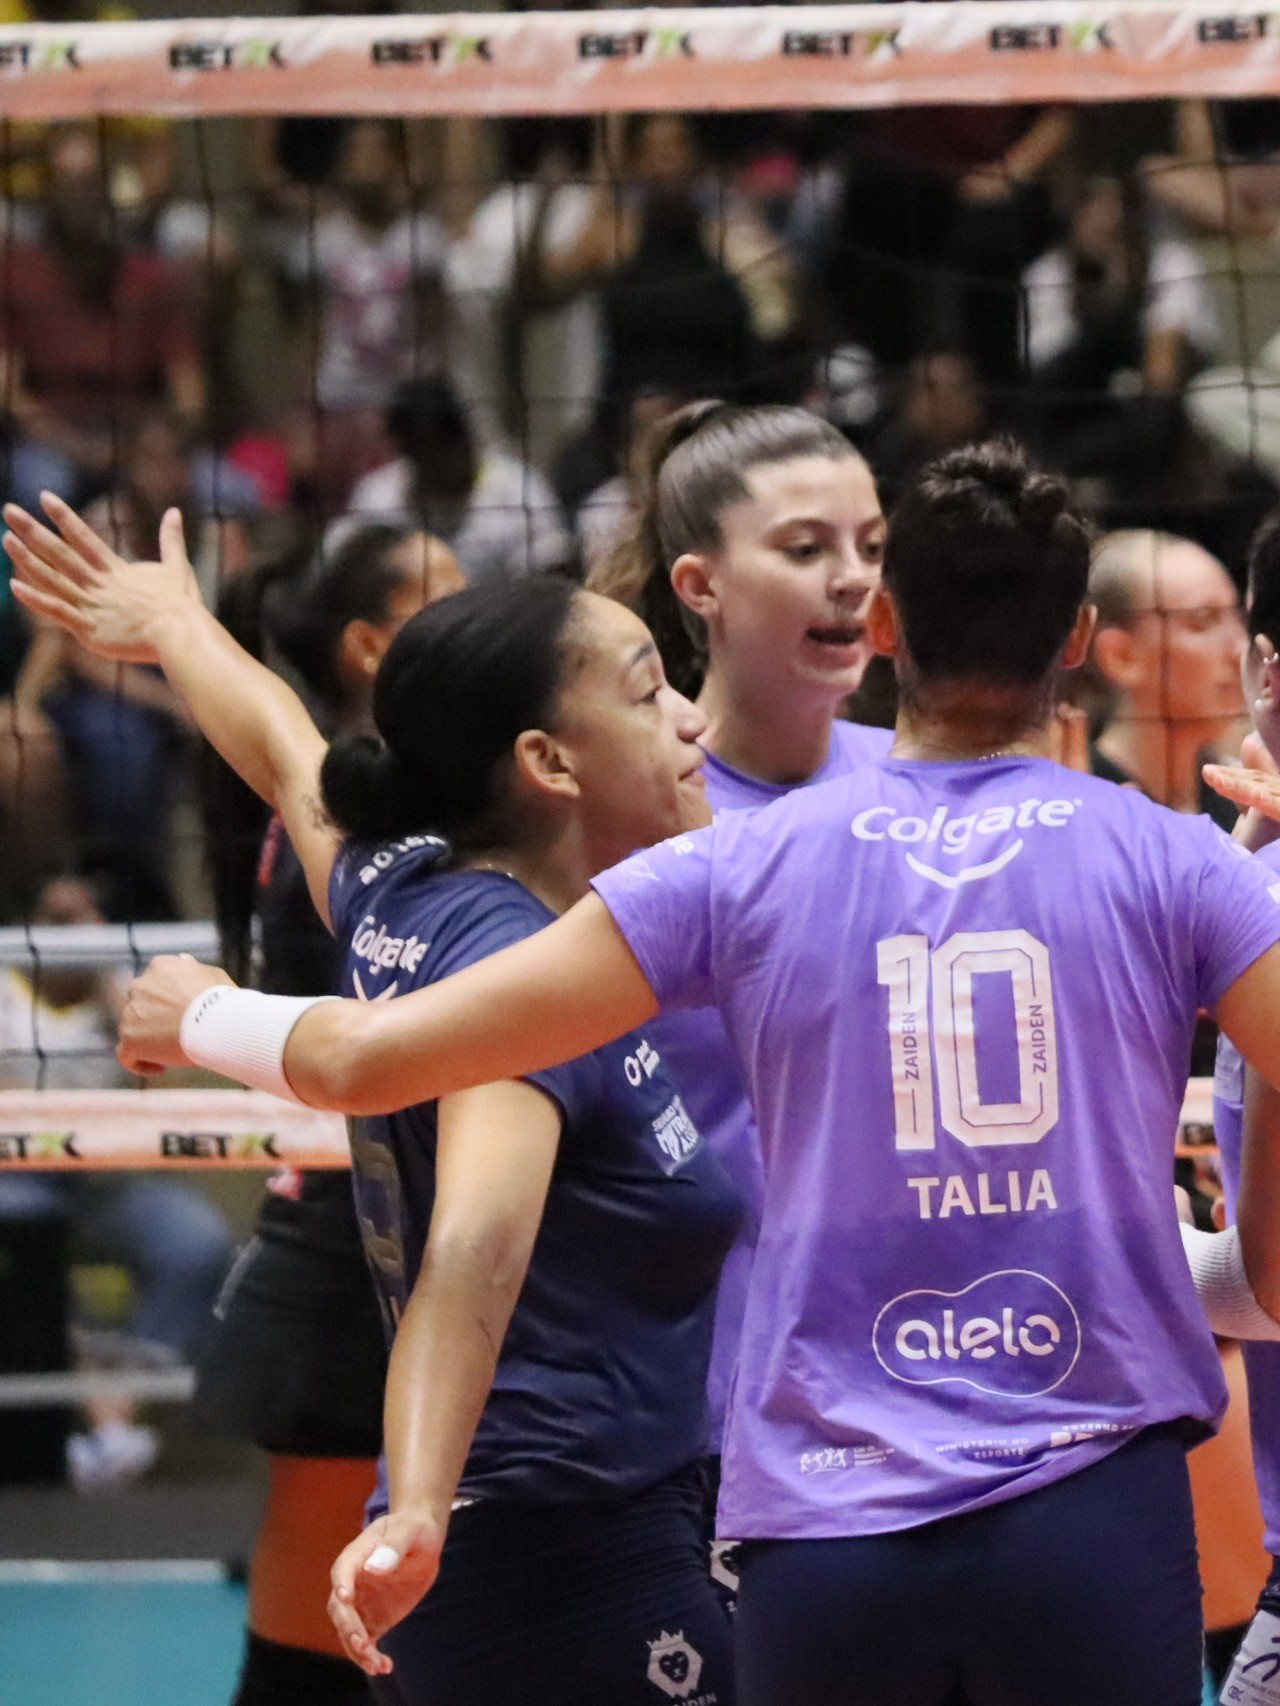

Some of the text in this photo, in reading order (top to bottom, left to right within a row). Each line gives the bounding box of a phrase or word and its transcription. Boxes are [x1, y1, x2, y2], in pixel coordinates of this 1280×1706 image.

[168, 38, 284, 71] BET7K
[371, 34, 492, 66] BET7K
[578, 29, 692, 60] BET7K
[988, 20, 1113, 53] BET7K
[851, 798, 1075, 855] Colgate
[351, 915, 431, 975] Colgate
[876, 929, 1059, 1150] 10
[902, 1011, 920, 1081] ZAIDEN
[1029, 1004, 1048, 1074] ZAIDEN
[160, 1131, 280, 1159] BET7K
[906, 1168, 1058, 1220] TALIA
[895, 1307, 1060, 1360] alelo
